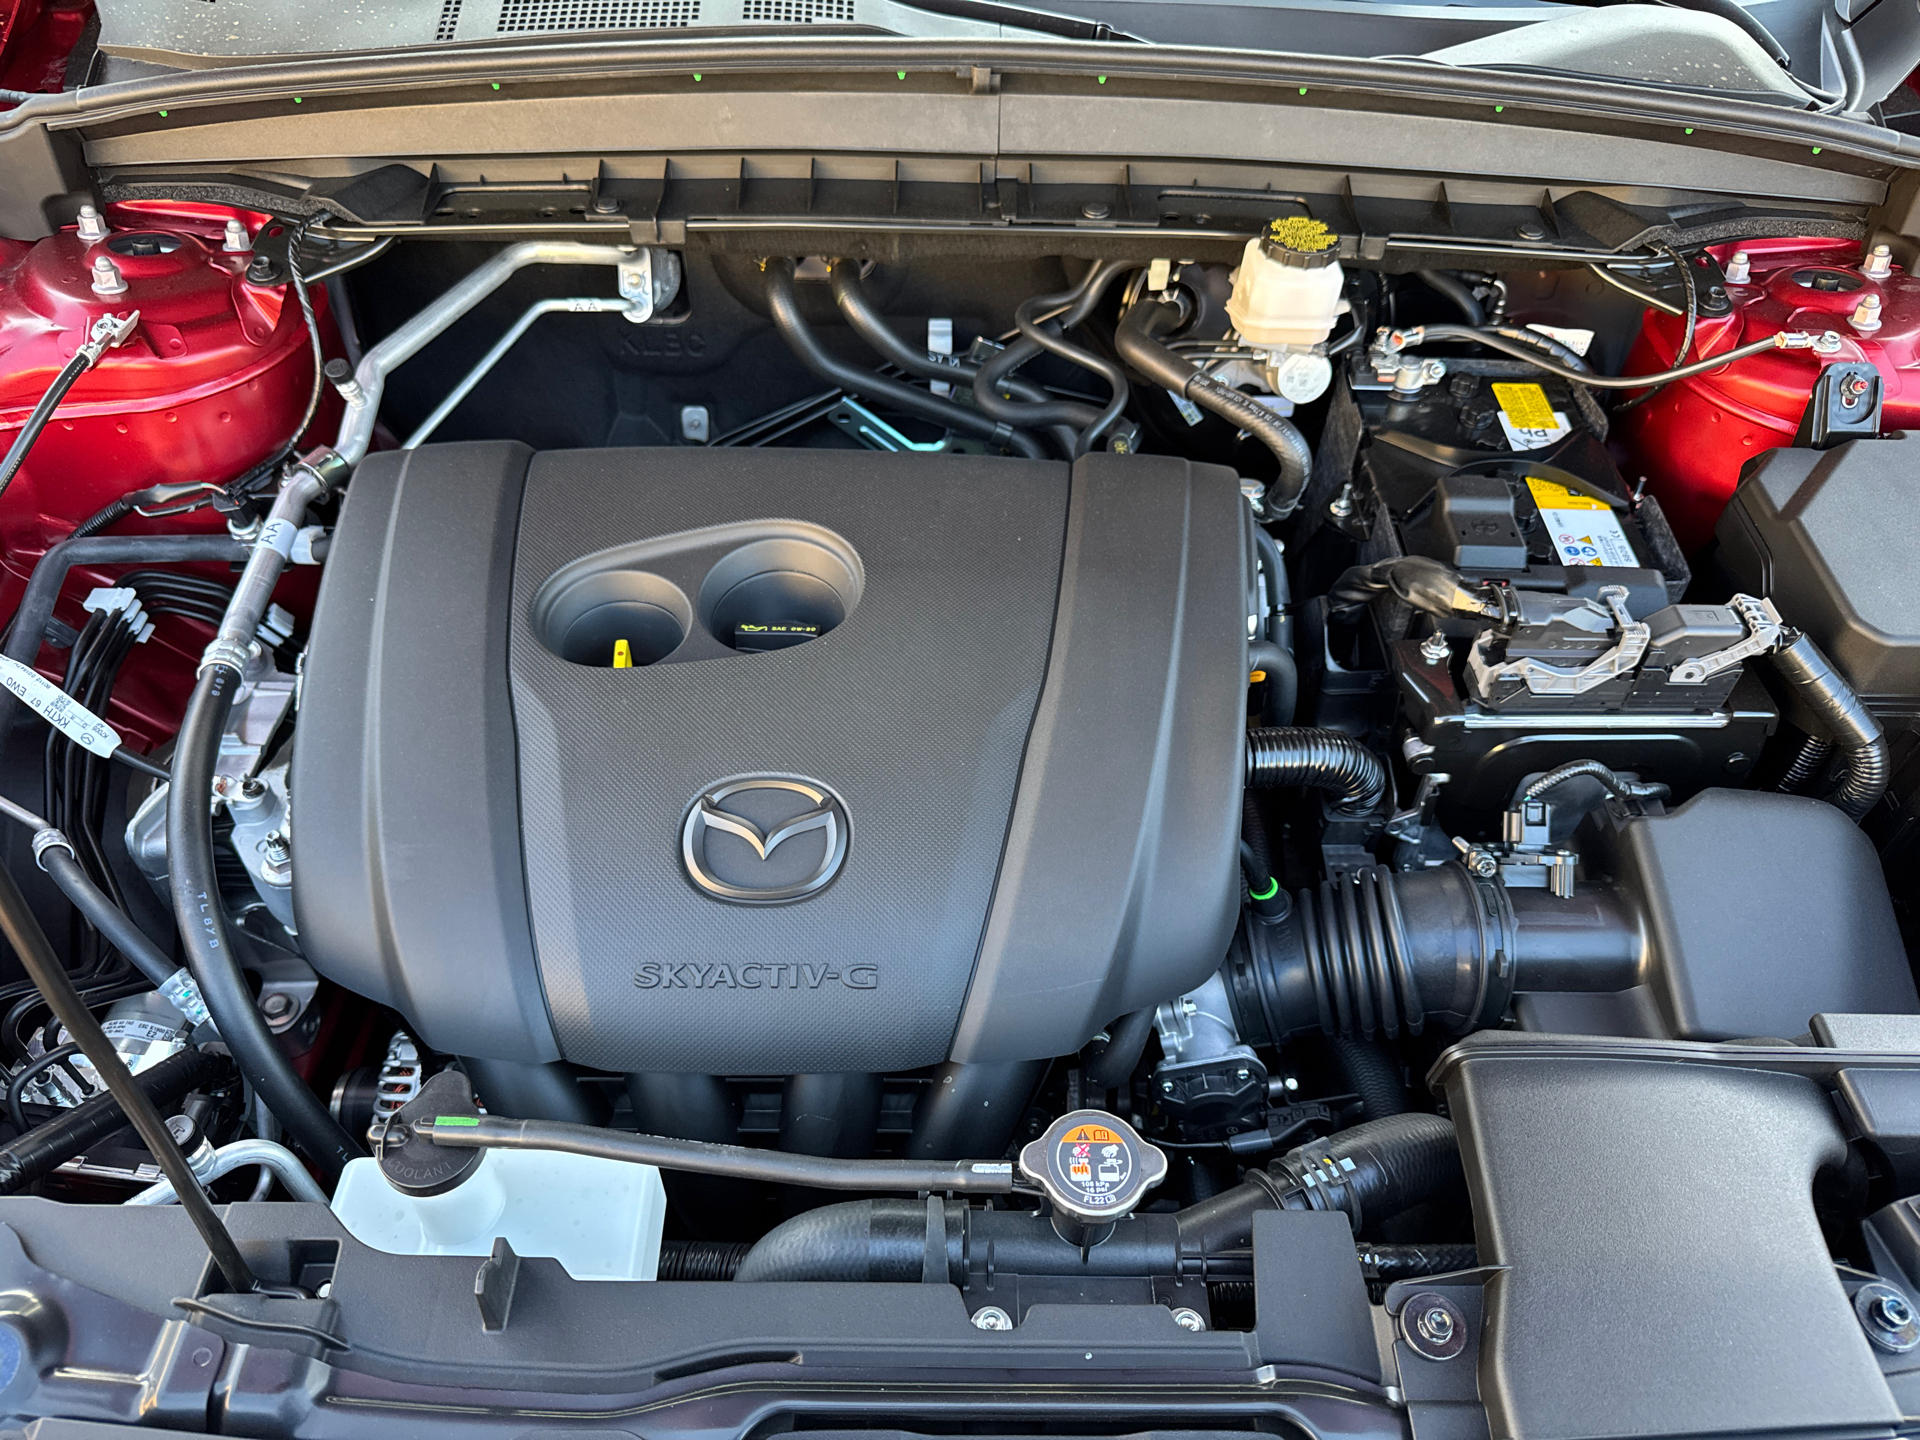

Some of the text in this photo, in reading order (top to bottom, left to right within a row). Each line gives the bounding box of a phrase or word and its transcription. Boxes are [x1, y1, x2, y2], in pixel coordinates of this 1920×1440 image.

[260, 522, 281, 545] AA
[30, 697, 42, 708] 67
[42, 705, 71, 730] KKTH
[634, 963, 878, 990] SKYACTIV-G
[145, 1030, 158, 1038] E2
[388, 1157, 452, 1180] COOLANT
[1083, 1195, 1106, 1205] FL22
